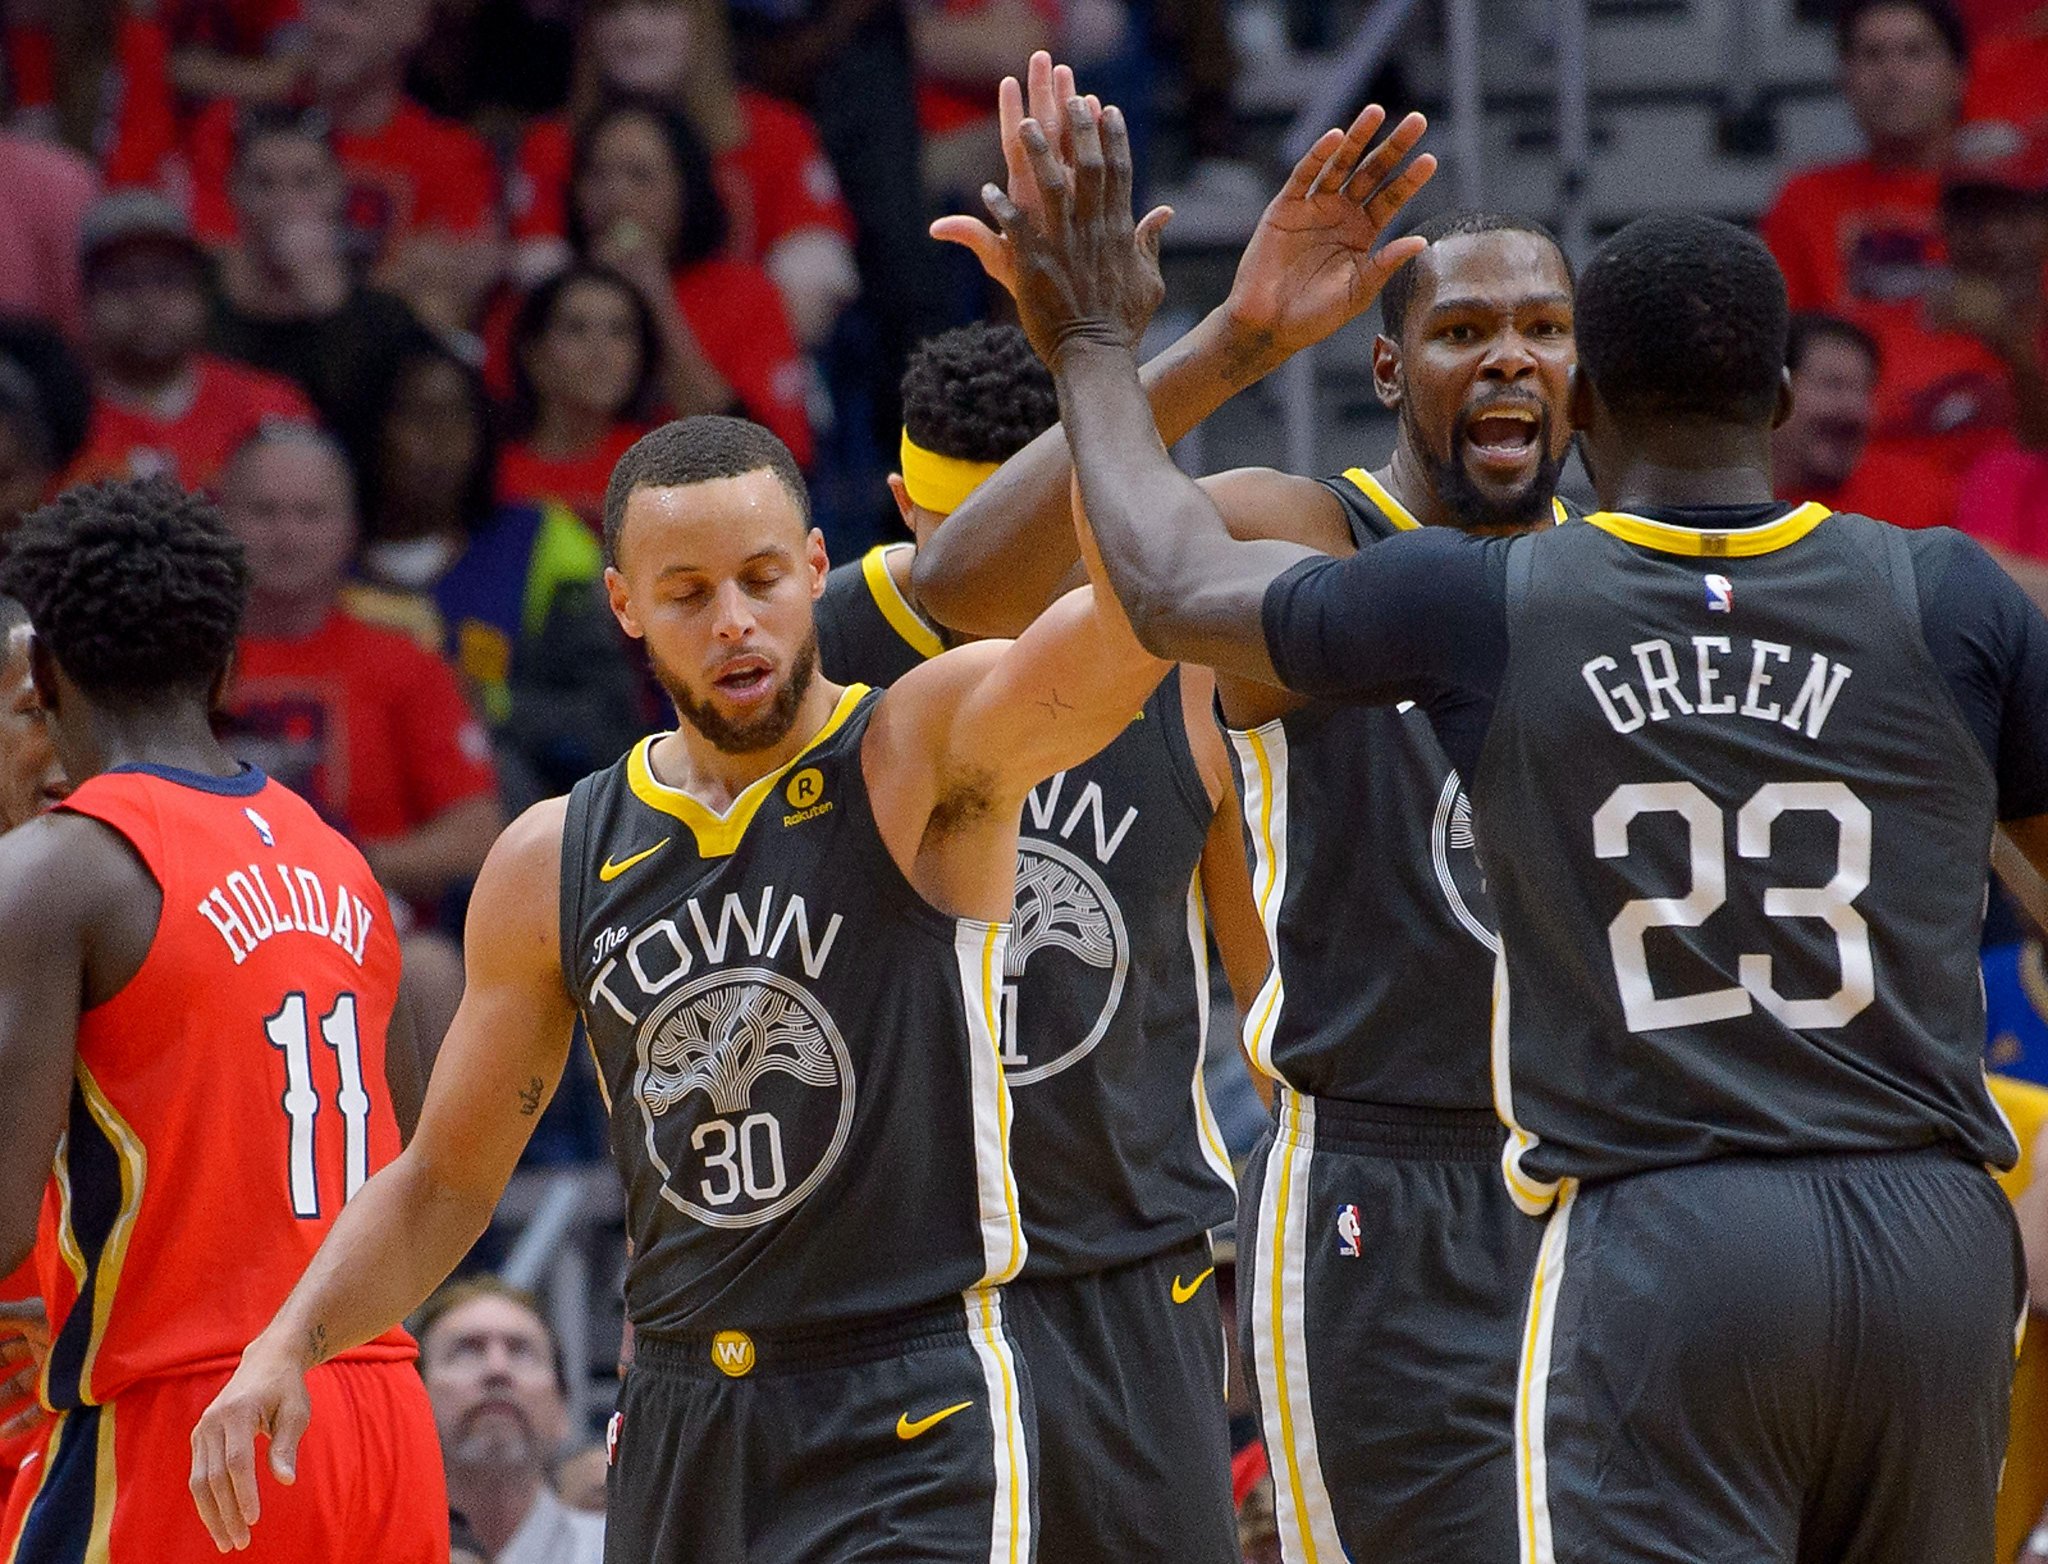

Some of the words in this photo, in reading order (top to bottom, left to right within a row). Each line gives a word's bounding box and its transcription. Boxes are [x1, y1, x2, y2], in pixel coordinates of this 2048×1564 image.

[1581, 635, 1852, 739] GREEN
[783, 801, 833, 828] Rakuten
[197, 864, 373, 967] HOLIDAY
[589, 885, 844, 1026] TOWN
[592, 925, 630, 965] The
[1592, 781, 1876, 1033] 23
[263, 990, 370, 1220] 11
[690, 1112, 787, 1206] 30
[716, 1342, 749, 1365] W
